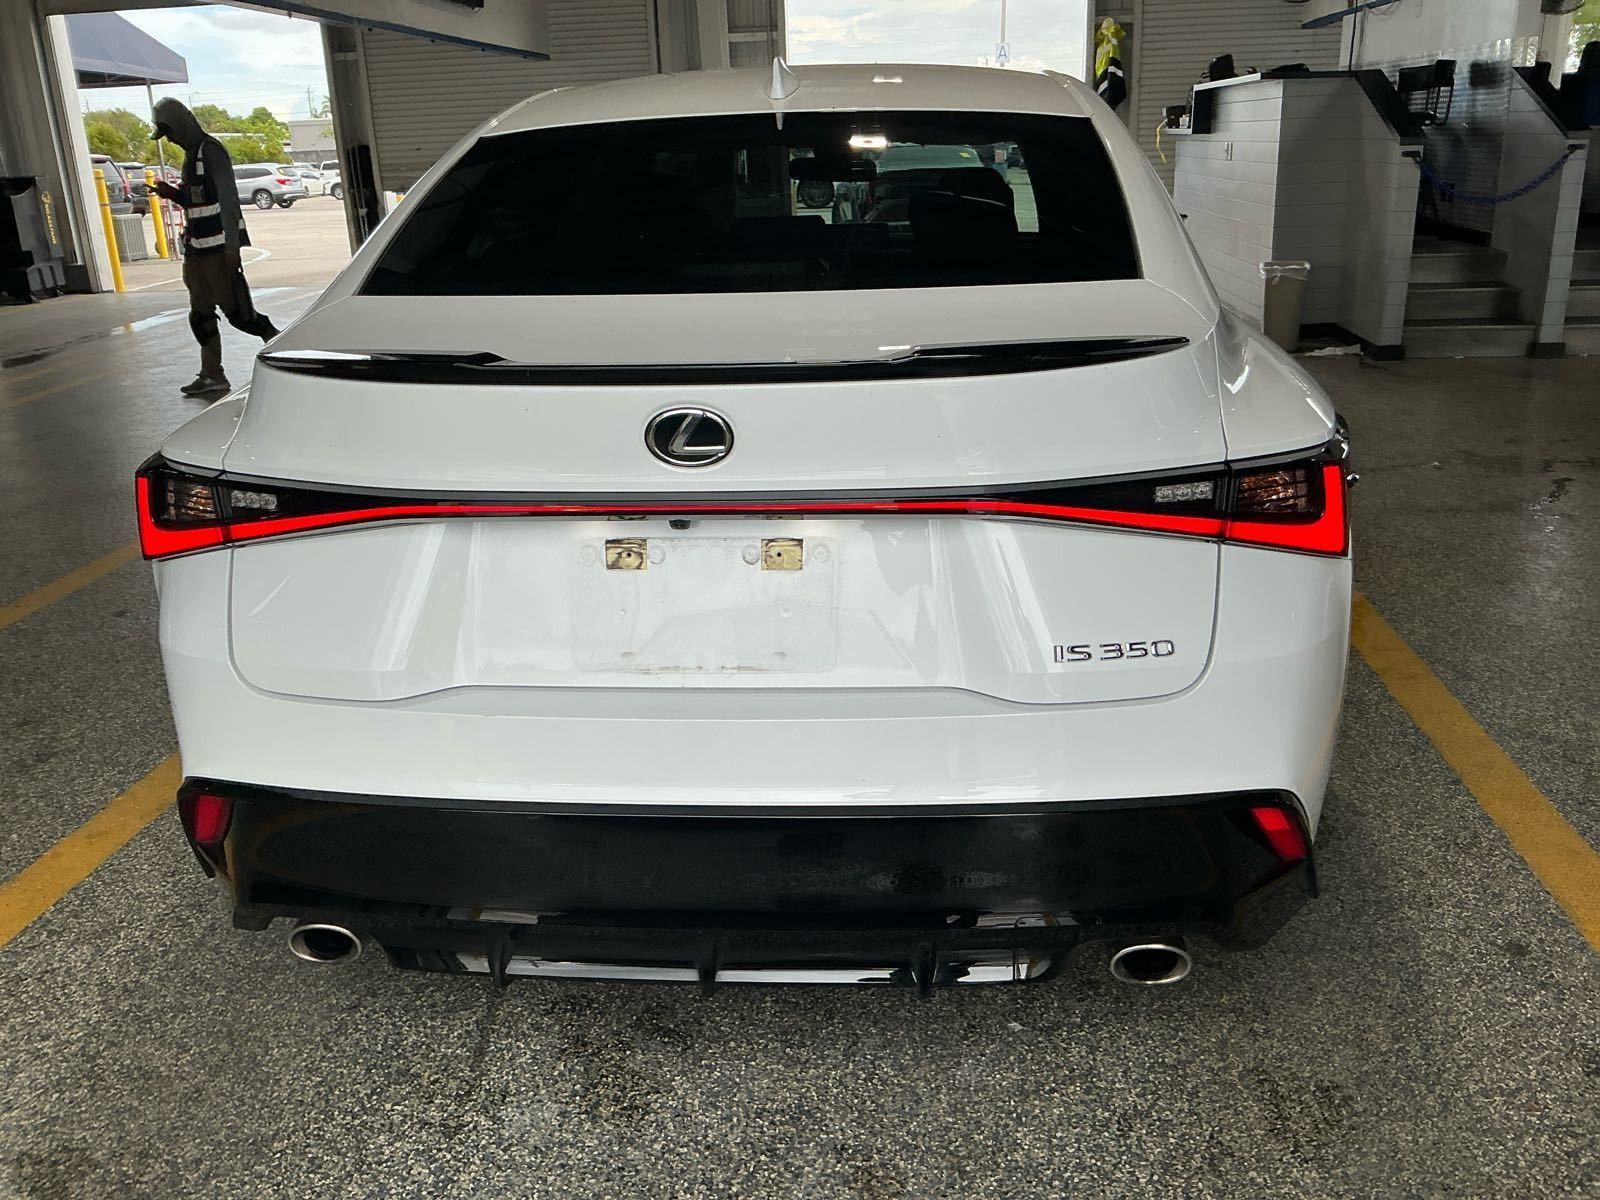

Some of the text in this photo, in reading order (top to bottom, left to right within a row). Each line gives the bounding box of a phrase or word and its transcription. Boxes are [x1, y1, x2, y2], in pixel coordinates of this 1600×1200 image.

[997, 45, 1008, 60] A
[1053, 639, 1175, 663] IS 350
